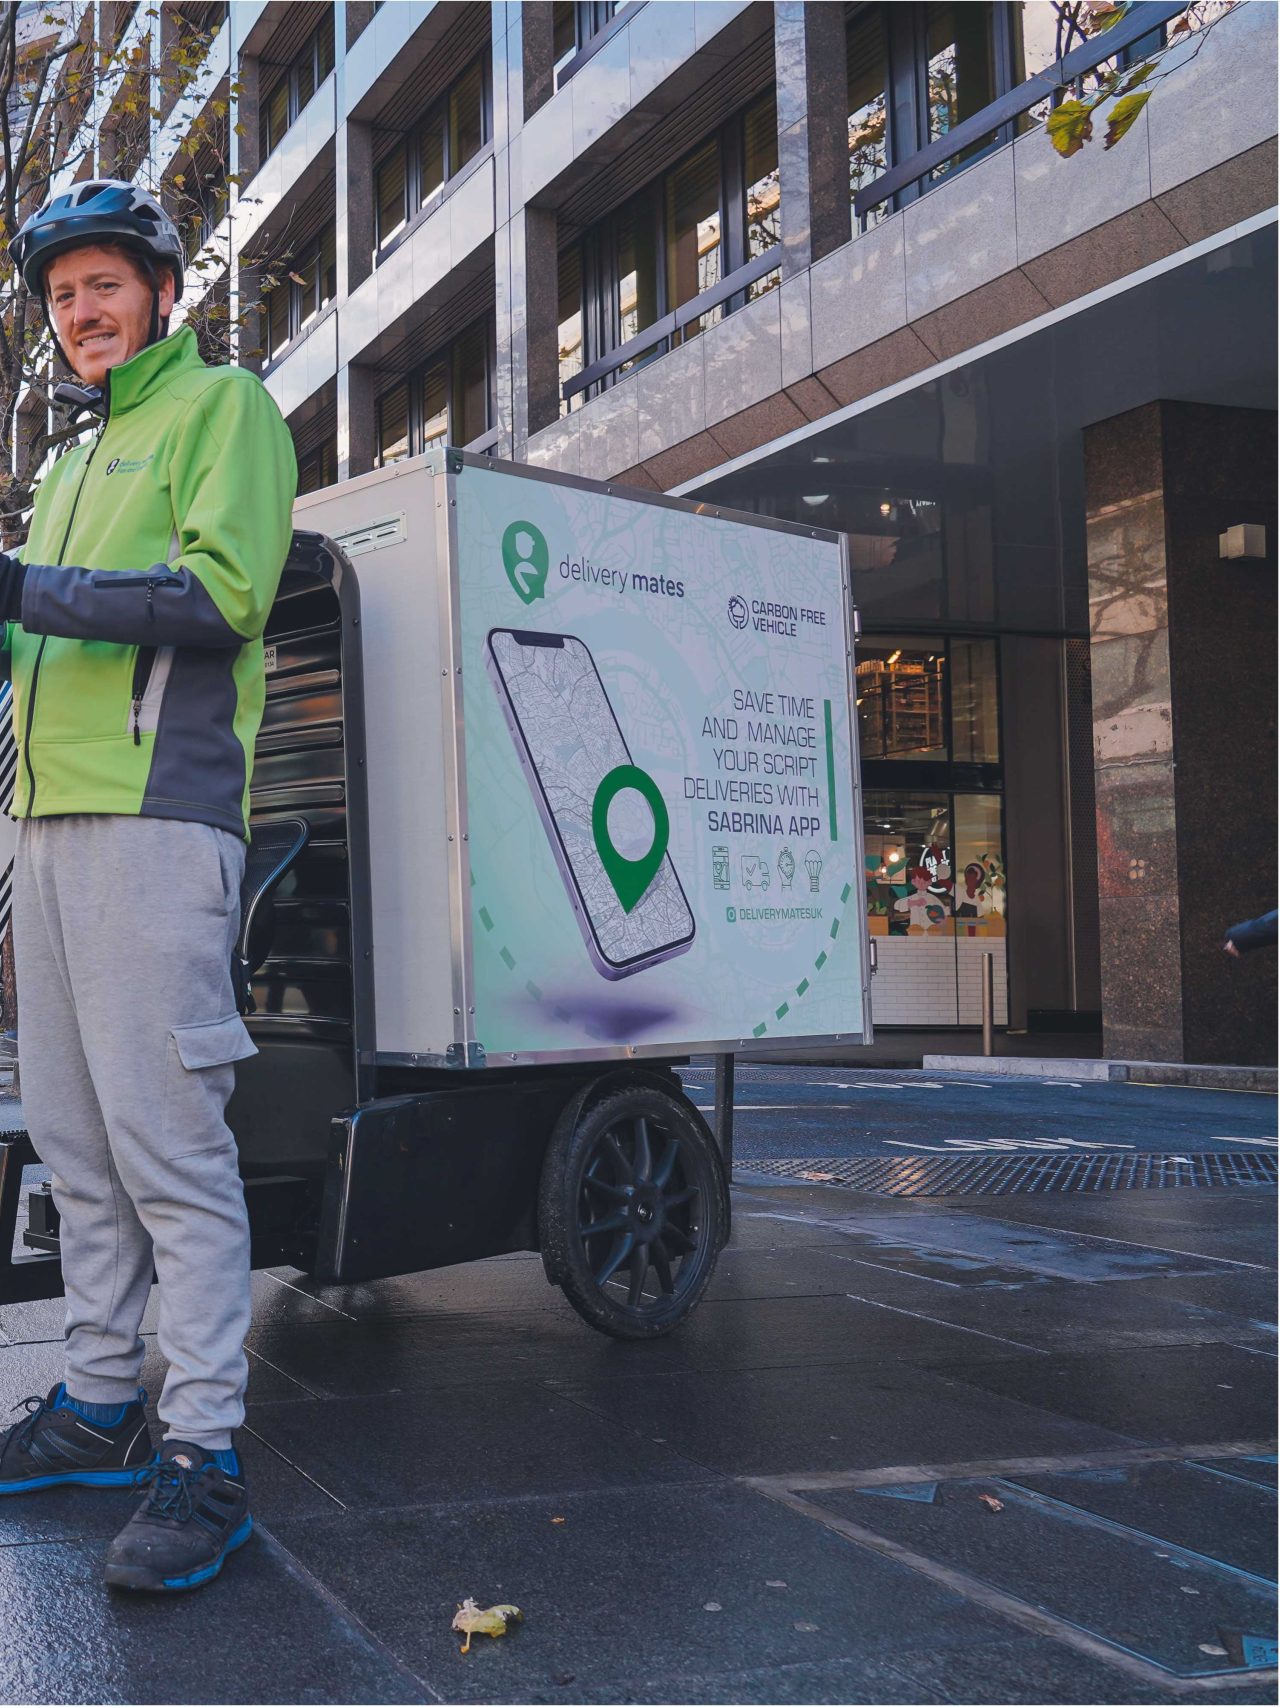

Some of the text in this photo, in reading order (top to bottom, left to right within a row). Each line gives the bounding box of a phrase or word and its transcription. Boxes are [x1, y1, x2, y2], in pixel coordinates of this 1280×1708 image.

[560, 553, 685, 598] delivery mates
[751, 600, 826, 626] CARBON FREE
[752, 617, 797, 637] VEHICLE
[733, 689, 815, 719] SAVE TIME
[701, 716, 817, 749] AND MANAGE
[713, 748, 818, 778] YOUR SCRIPT
[683, 777, 819, 808] DELIVERIES WITH
[707, 810, 820, 837] SABRINA APP
[739, 907, 823, 920] DELIVERYMATESUK
[881, 1137, 1137, 1152] LOOK
